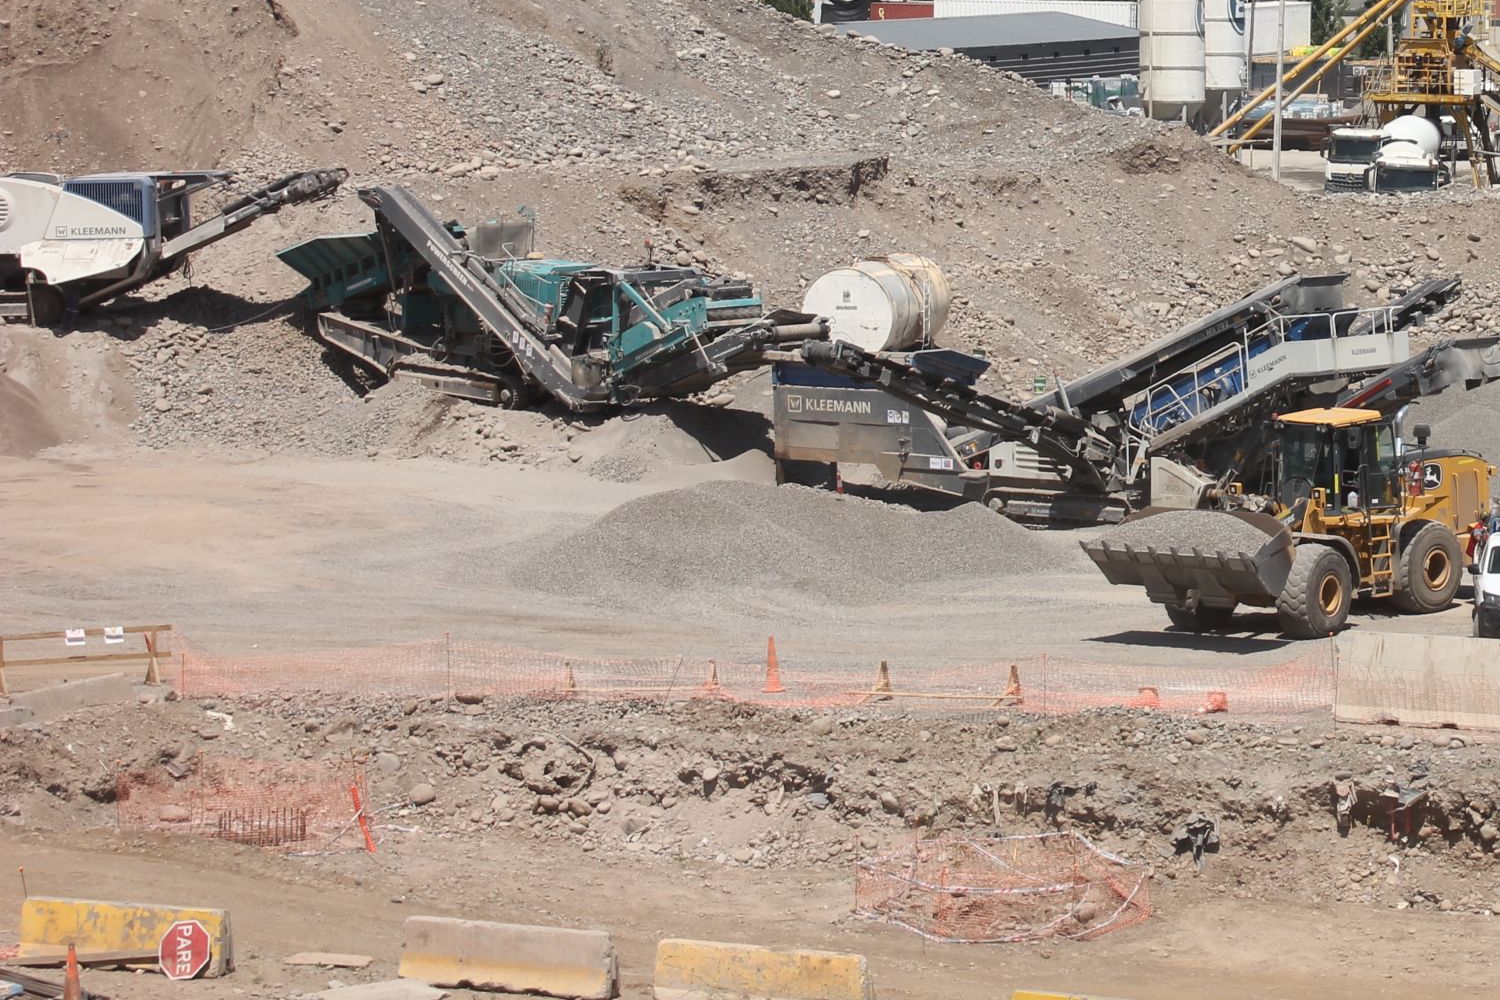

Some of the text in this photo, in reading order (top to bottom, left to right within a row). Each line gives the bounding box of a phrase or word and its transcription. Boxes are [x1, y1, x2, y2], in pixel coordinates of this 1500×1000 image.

[71, 227, 126, 236] KLEEMANN
[805, 398, 871, 414] KLEEMANN
[176, 925, 193, 975] PARE
